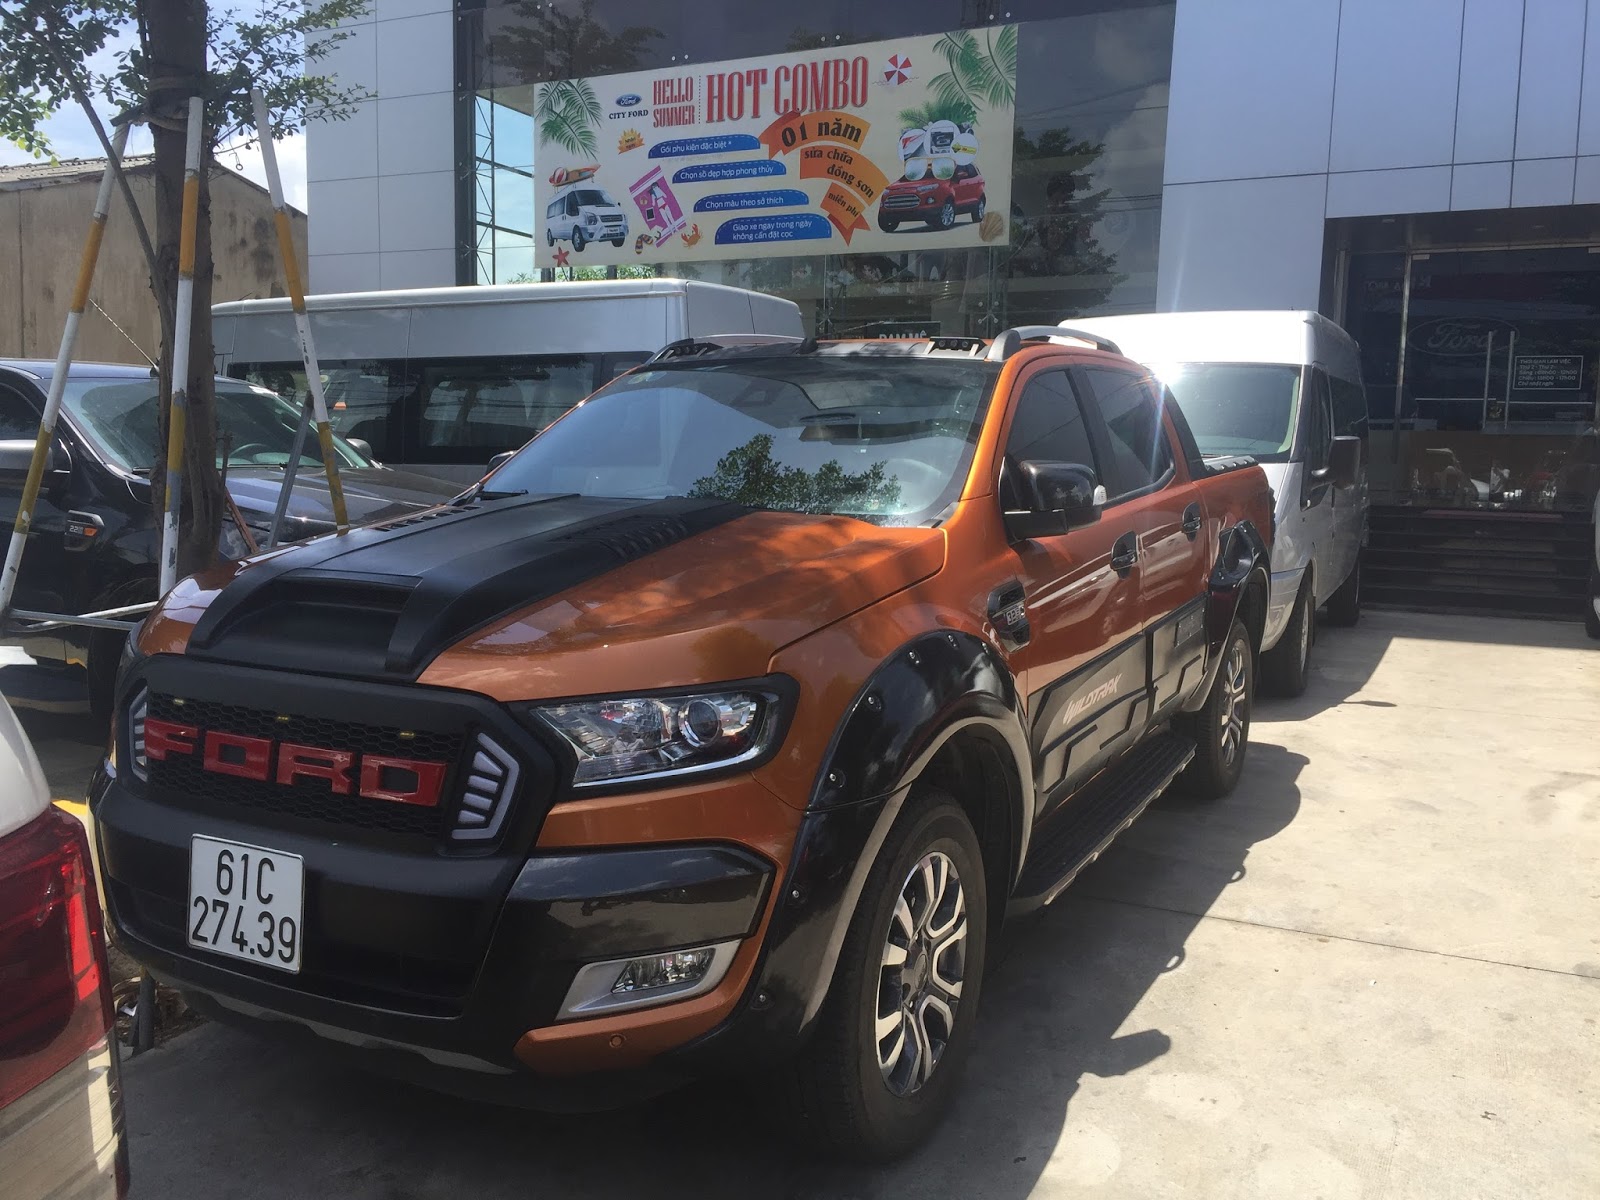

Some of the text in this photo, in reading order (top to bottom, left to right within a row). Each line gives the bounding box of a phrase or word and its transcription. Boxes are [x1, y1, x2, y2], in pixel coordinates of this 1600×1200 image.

[653, 76, 694, 106] HELLO
[706, 56, 869, 124] HOT COMBO
[608, 109, 649, 120] CITY FORD
[653, 105, 695, 129] SUMMER
[781, 117, 862, 147] 01 năm
[804, 147, 854, 165] sửa chữa
[680, 171, 698, 181] Chọn
[735, 167, 757, 176] phong
[856, 180, 874, 198] sơn
[705, 201, 723, 210] Chọn
[740, 199, 757, 207] theo
[766, 197, 784, 205] thích
[732, 223, 749, 231] Giao
[758, 222, 775, 231] ngay
[775, 221, 794, 230] trong
[732, 231, 754, 241] không
[1062, 673, 1123, 725] WILDTRAK
[144, 717, 448, 808] FORD
[216, 849, 276, 905] 61C
[191, 895, 297, 965] 274.39
